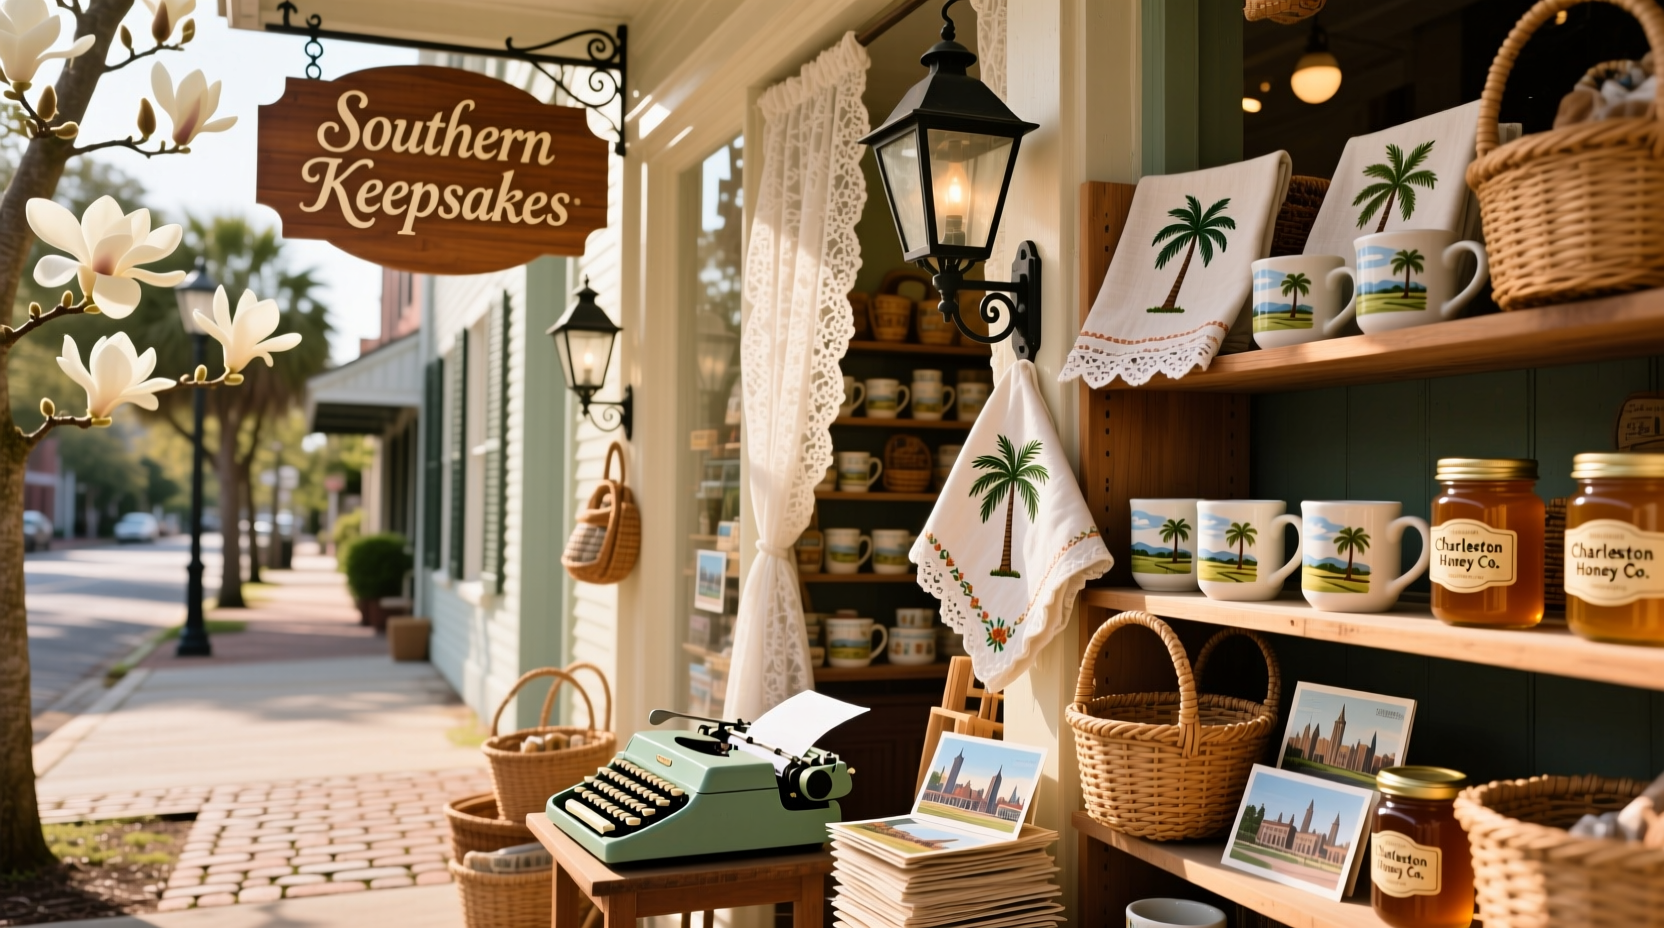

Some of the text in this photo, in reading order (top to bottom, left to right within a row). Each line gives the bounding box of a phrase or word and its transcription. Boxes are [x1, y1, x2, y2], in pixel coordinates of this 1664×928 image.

[316, 89, 556, 166] Southern
[1434, 536, 1503, 554] Charleston
[1571, 542, 1654, 561] Charleston
[1477, 554, 1500, 569] Co.
[1576, 561, 1651, 583] Honey Co.
